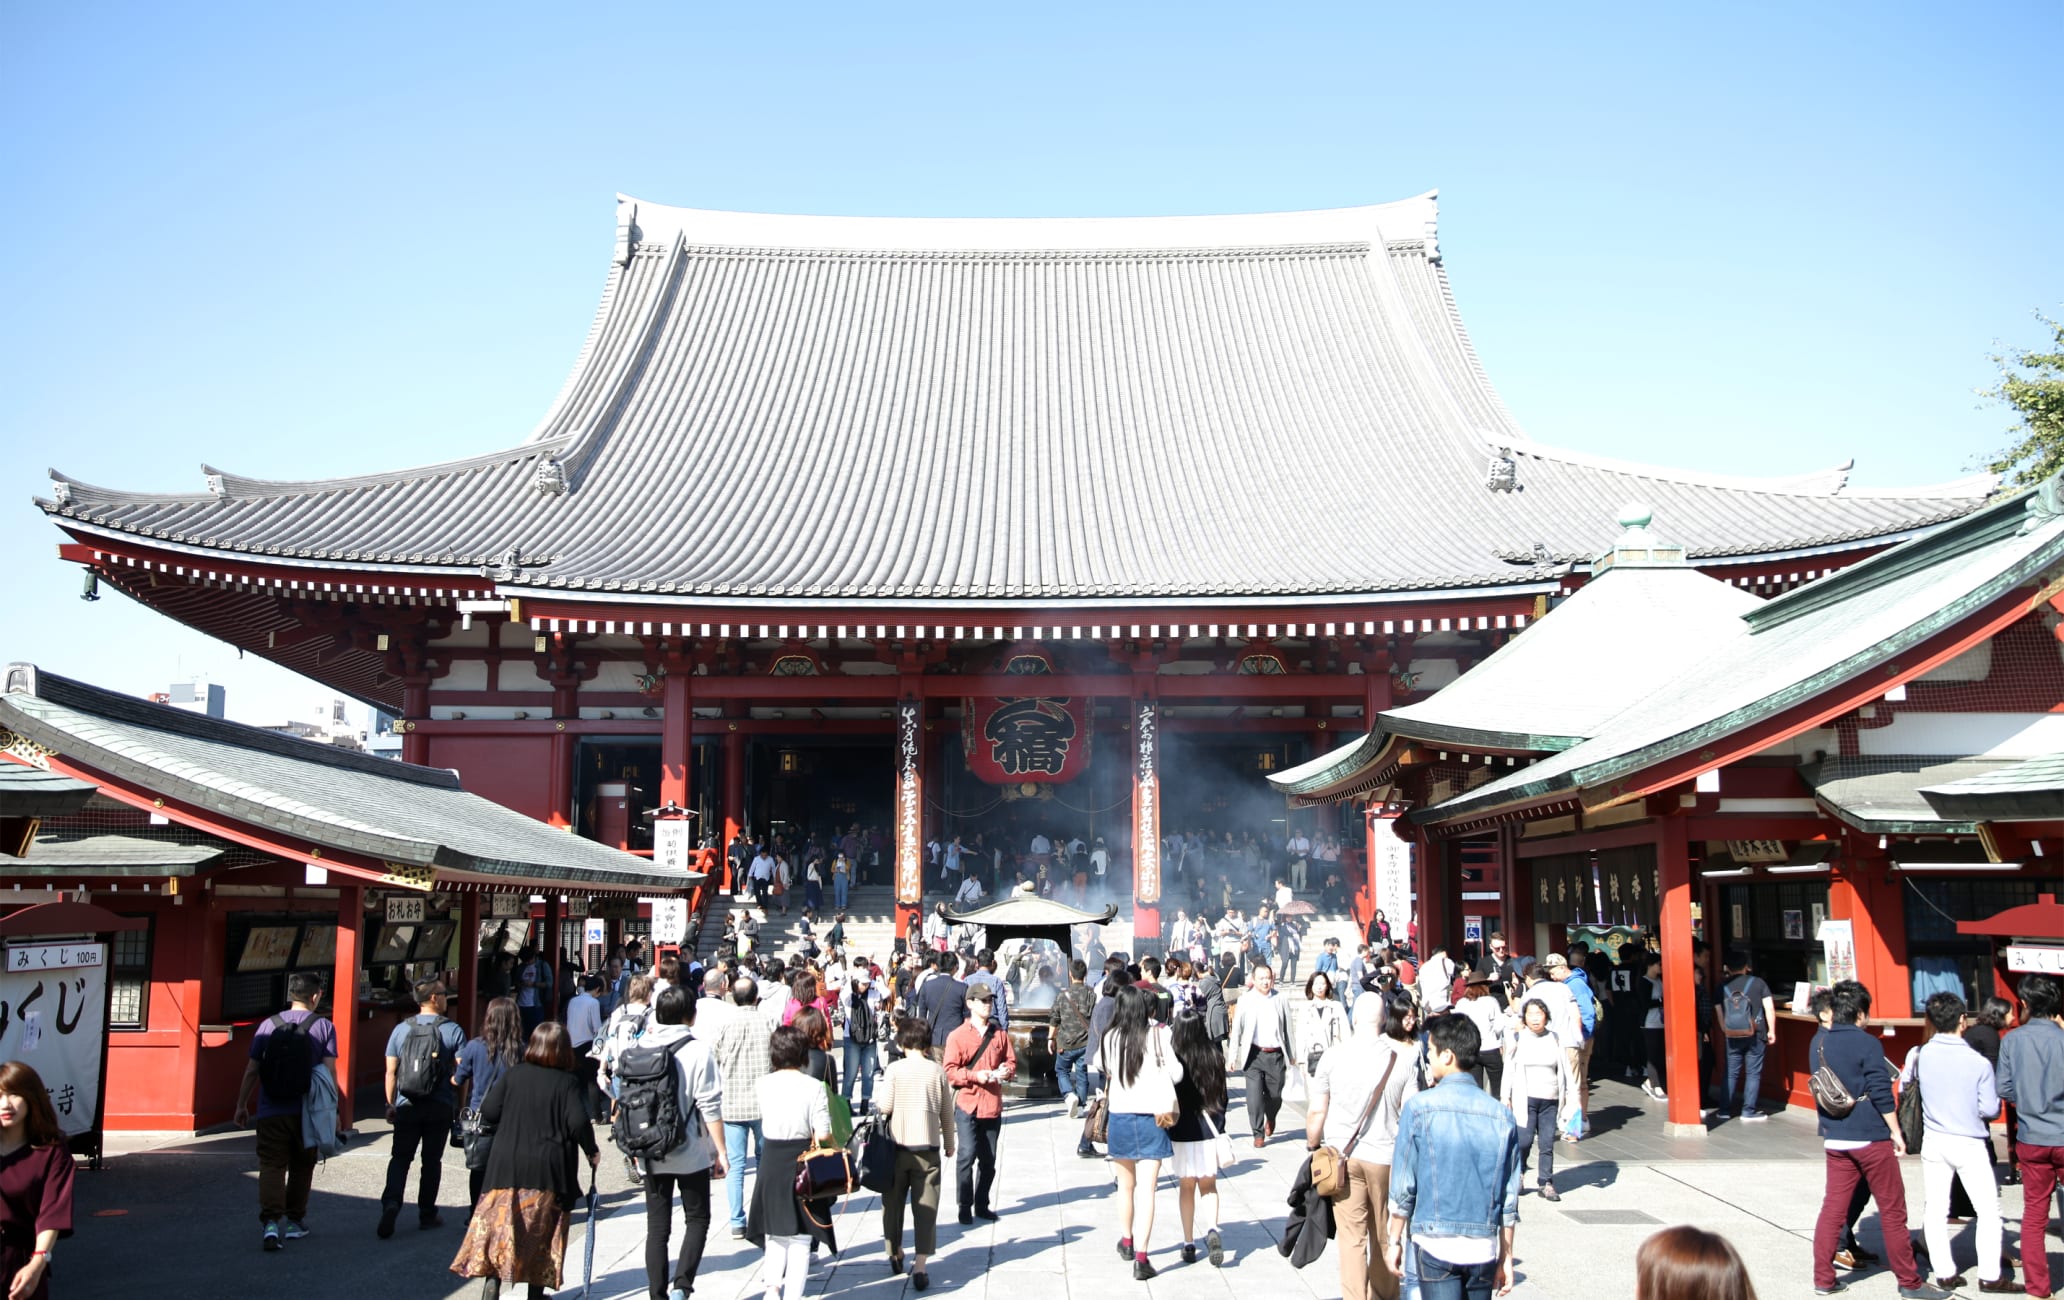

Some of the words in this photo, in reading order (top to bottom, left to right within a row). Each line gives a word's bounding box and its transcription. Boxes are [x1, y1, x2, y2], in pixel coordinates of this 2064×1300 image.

[388, 899, 421, 921] お札お守
[76, 951, 97, 964] 100円
